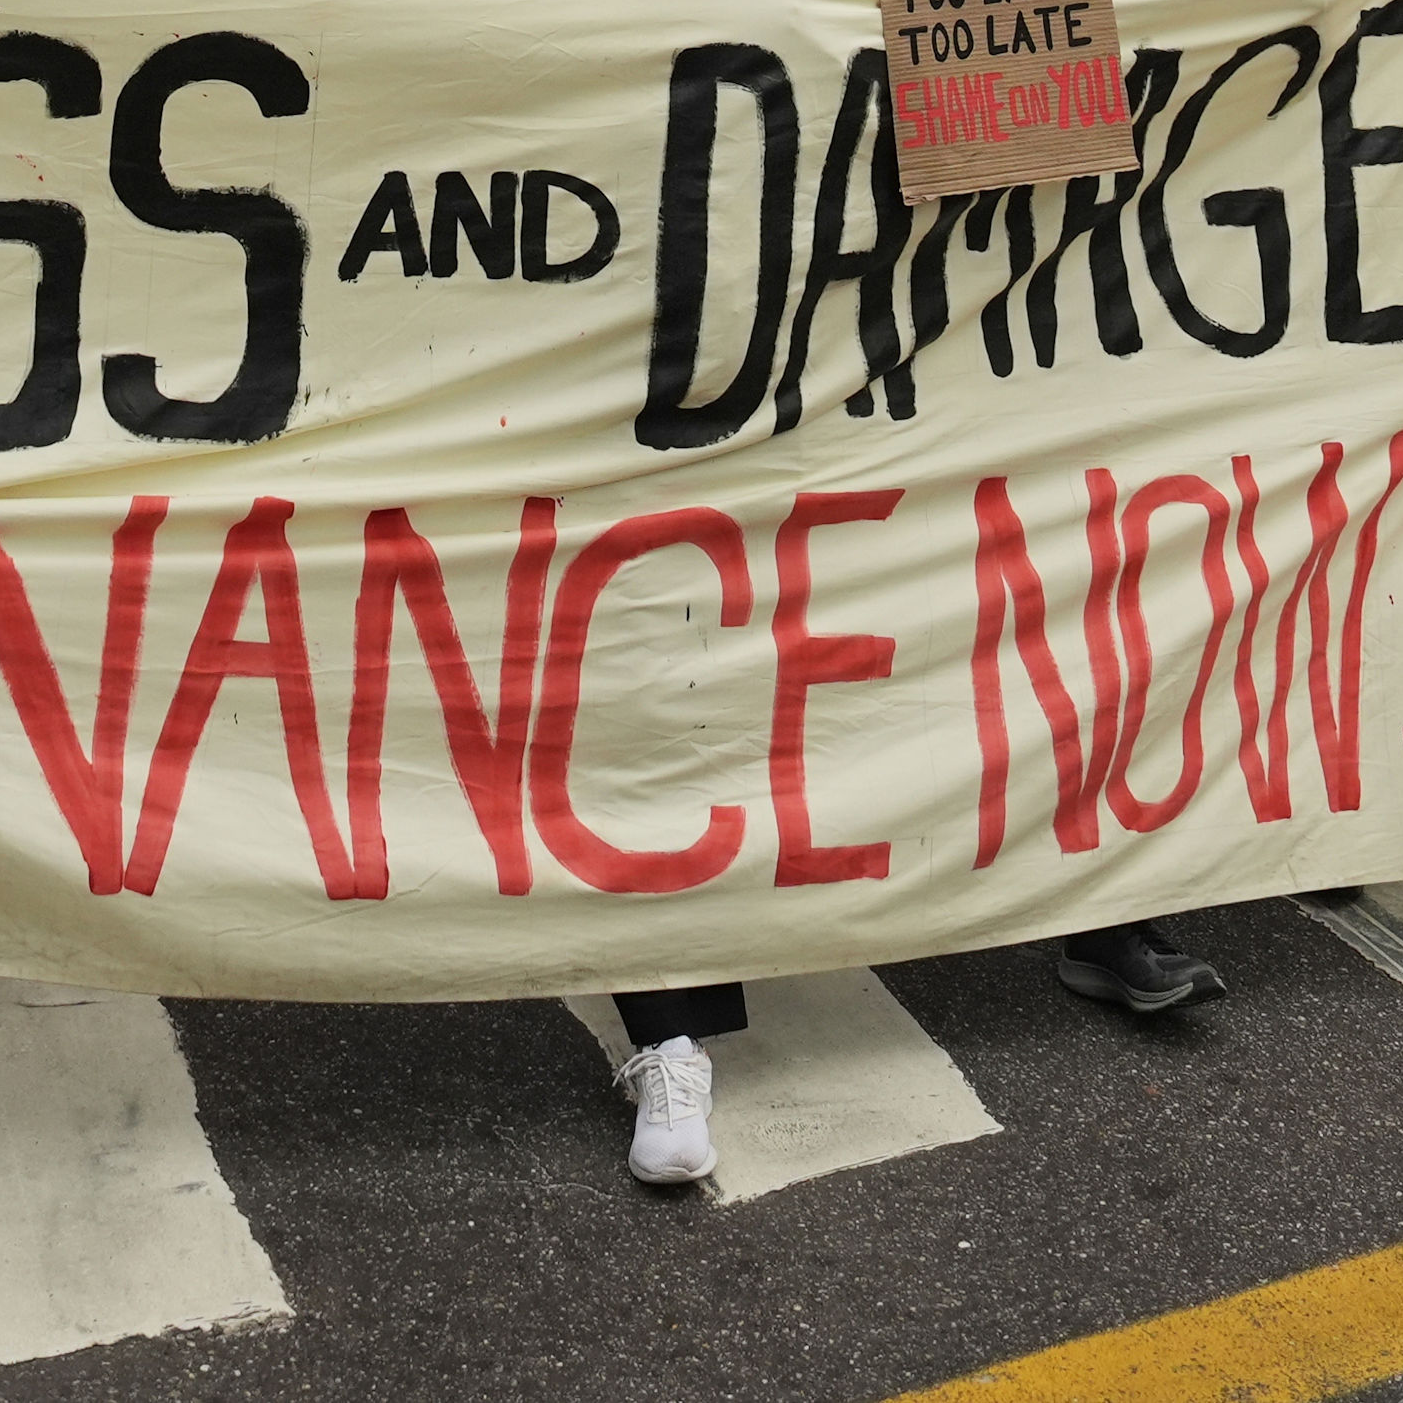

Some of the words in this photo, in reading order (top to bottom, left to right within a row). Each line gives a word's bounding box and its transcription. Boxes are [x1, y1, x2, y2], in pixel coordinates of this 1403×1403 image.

[898, 18, 975, 66] TOO
[986, 2, 1093, 57] LATE
[896, 72, 1010, 149] SHAME
[1008, 82, 1051, 128] ON
[1047, 55, 1127, 130] YOU
[337, 170, 621, 286] AND
